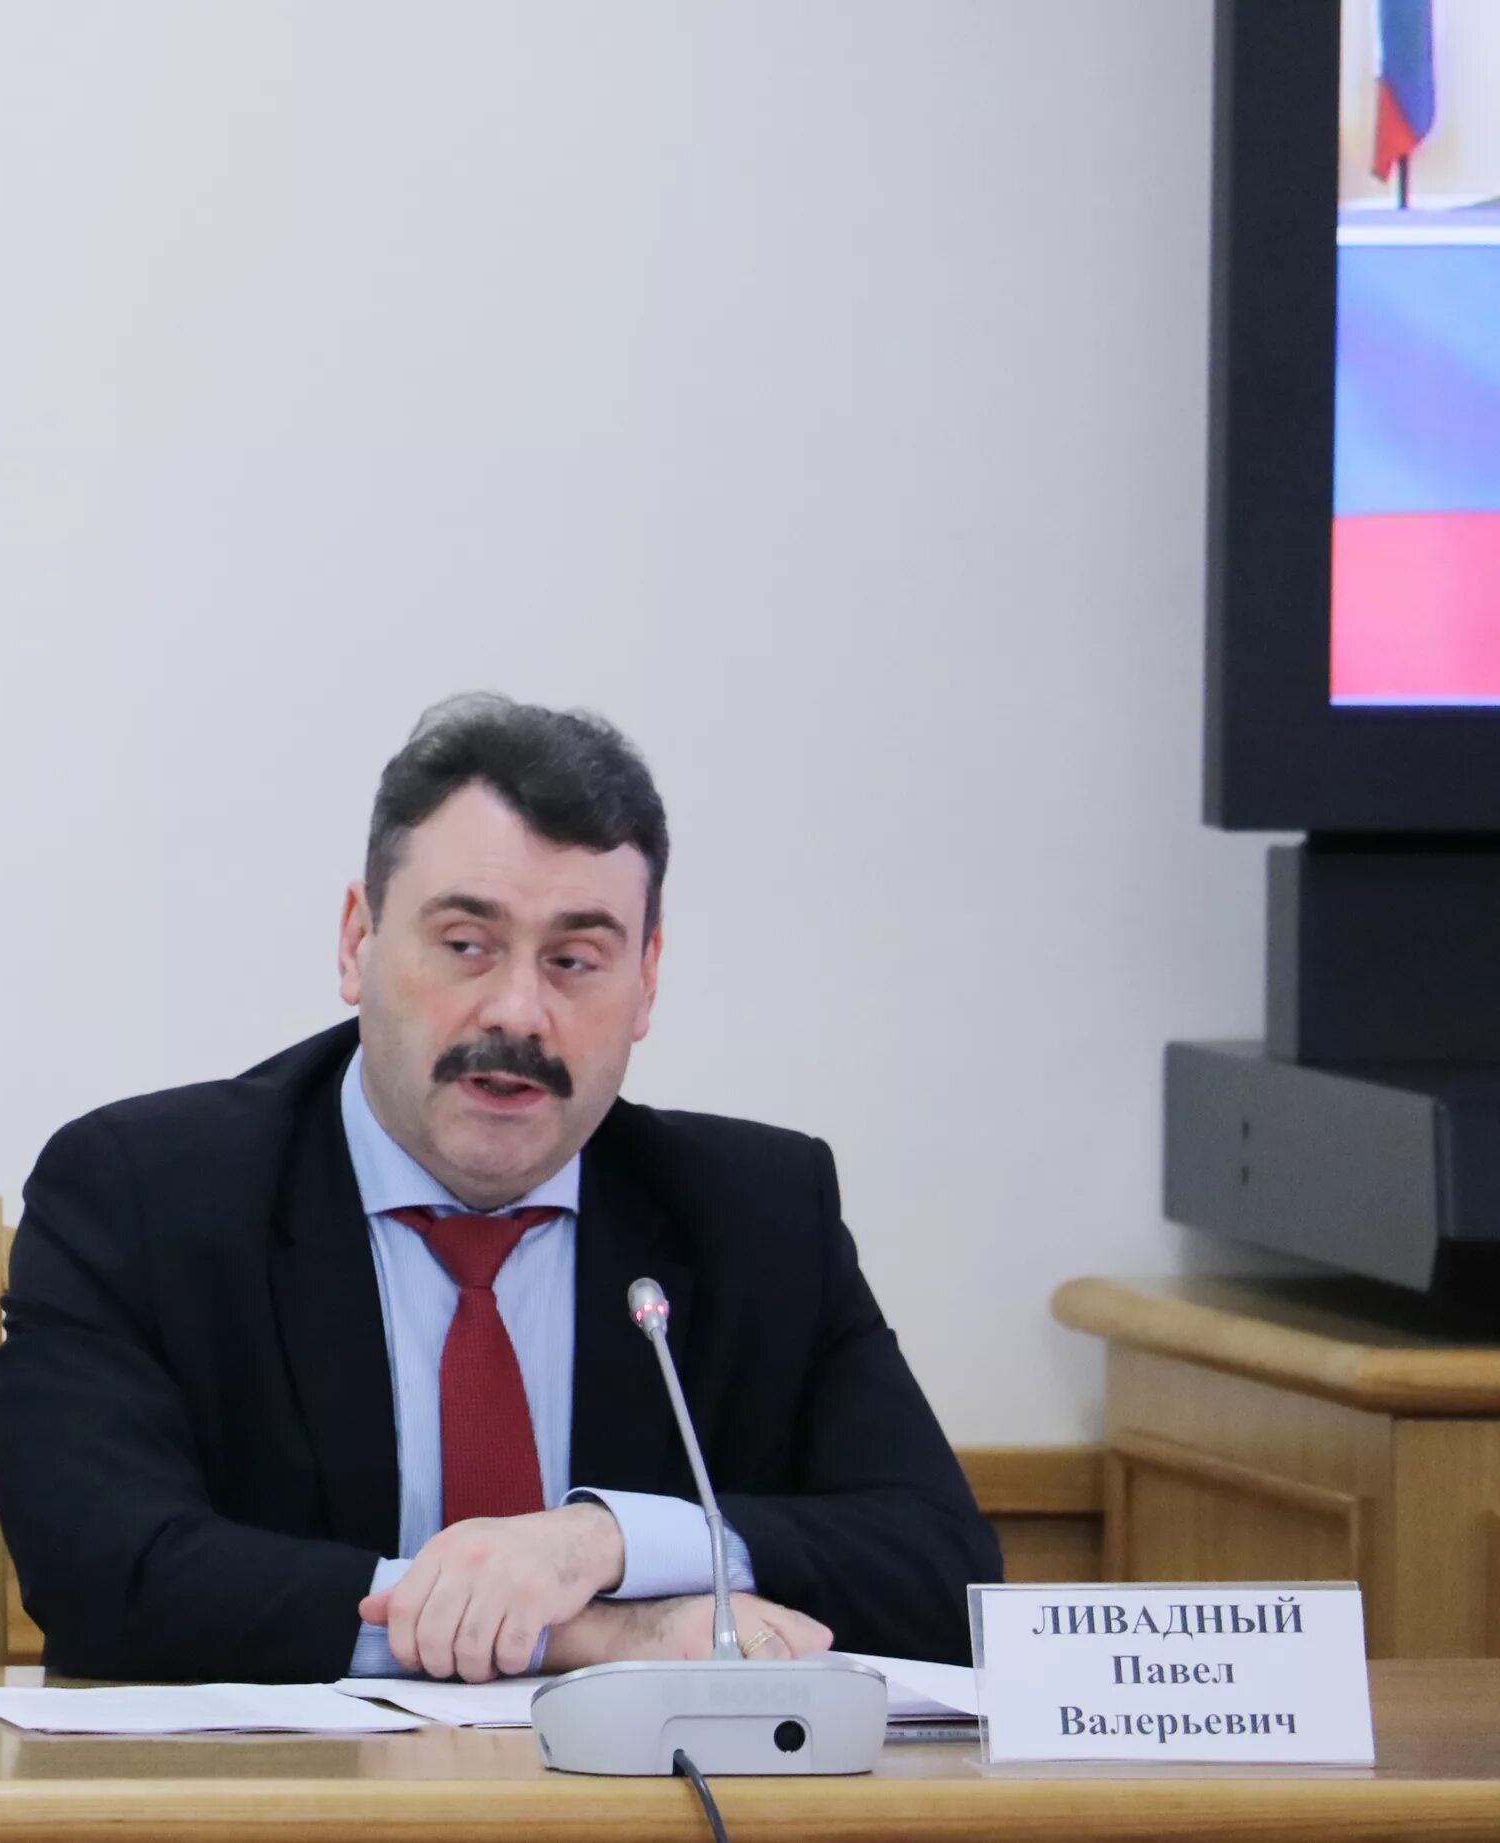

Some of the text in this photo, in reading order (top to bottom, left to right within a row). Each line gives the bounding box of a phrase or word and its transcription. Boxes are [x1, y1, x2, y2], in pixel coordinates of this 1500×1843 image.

[1032, 1596, 1305, 1640] ЛИВАДНЫЙ
[1112, 1655, 1236, 1685] Павел
[1059, 1705, 1297, 1744] Валерьевич
